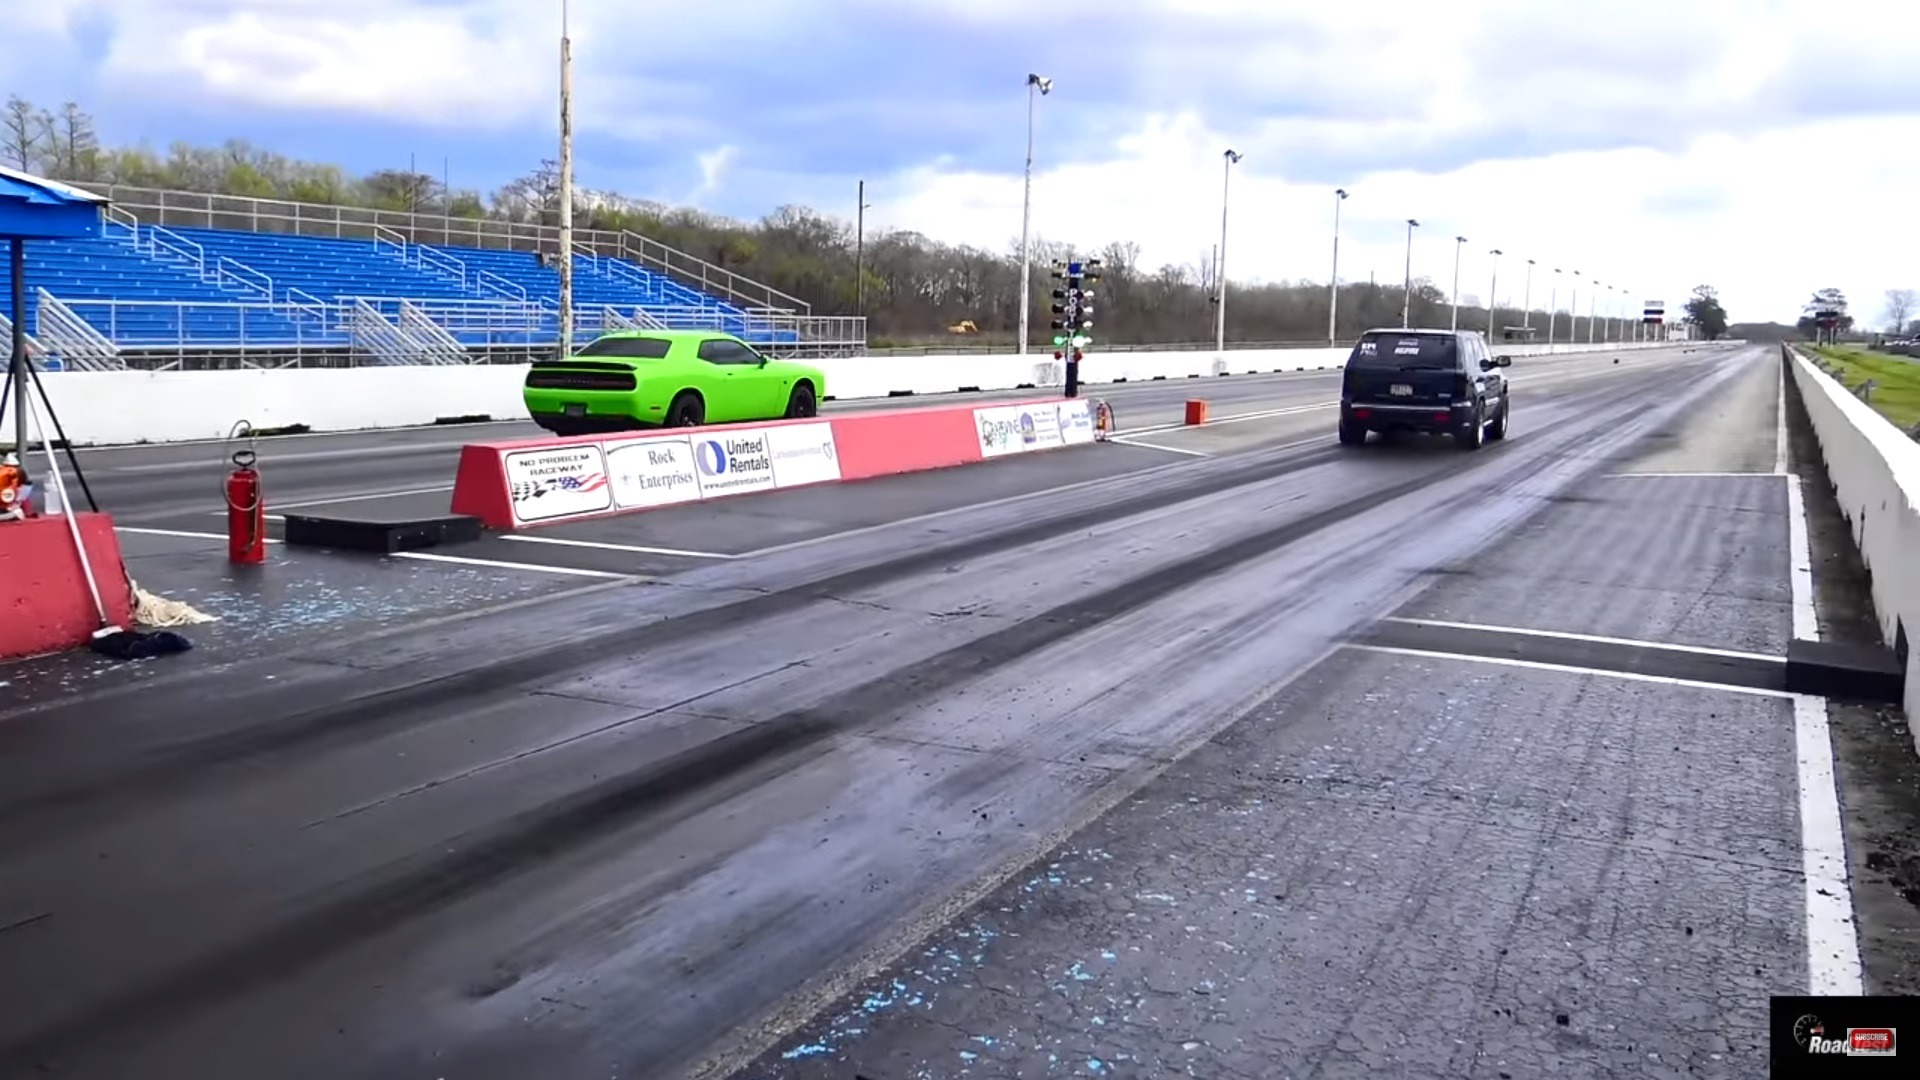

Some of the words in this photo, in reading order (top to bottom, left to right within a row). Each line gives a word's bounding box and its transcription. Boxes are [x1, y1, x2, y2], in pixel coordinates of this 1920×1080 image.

[725, 437, 763, 456] United
[519, 459, 536, 467] NO
[538, 454, 590, 465] PROBLEM
[648, 448, 676, 466] Rock
[729, 454, 770, 474] Rentals
[530, 464, 583, 476] RACEWAY
[639, 470, 693, 490] Enterprises
